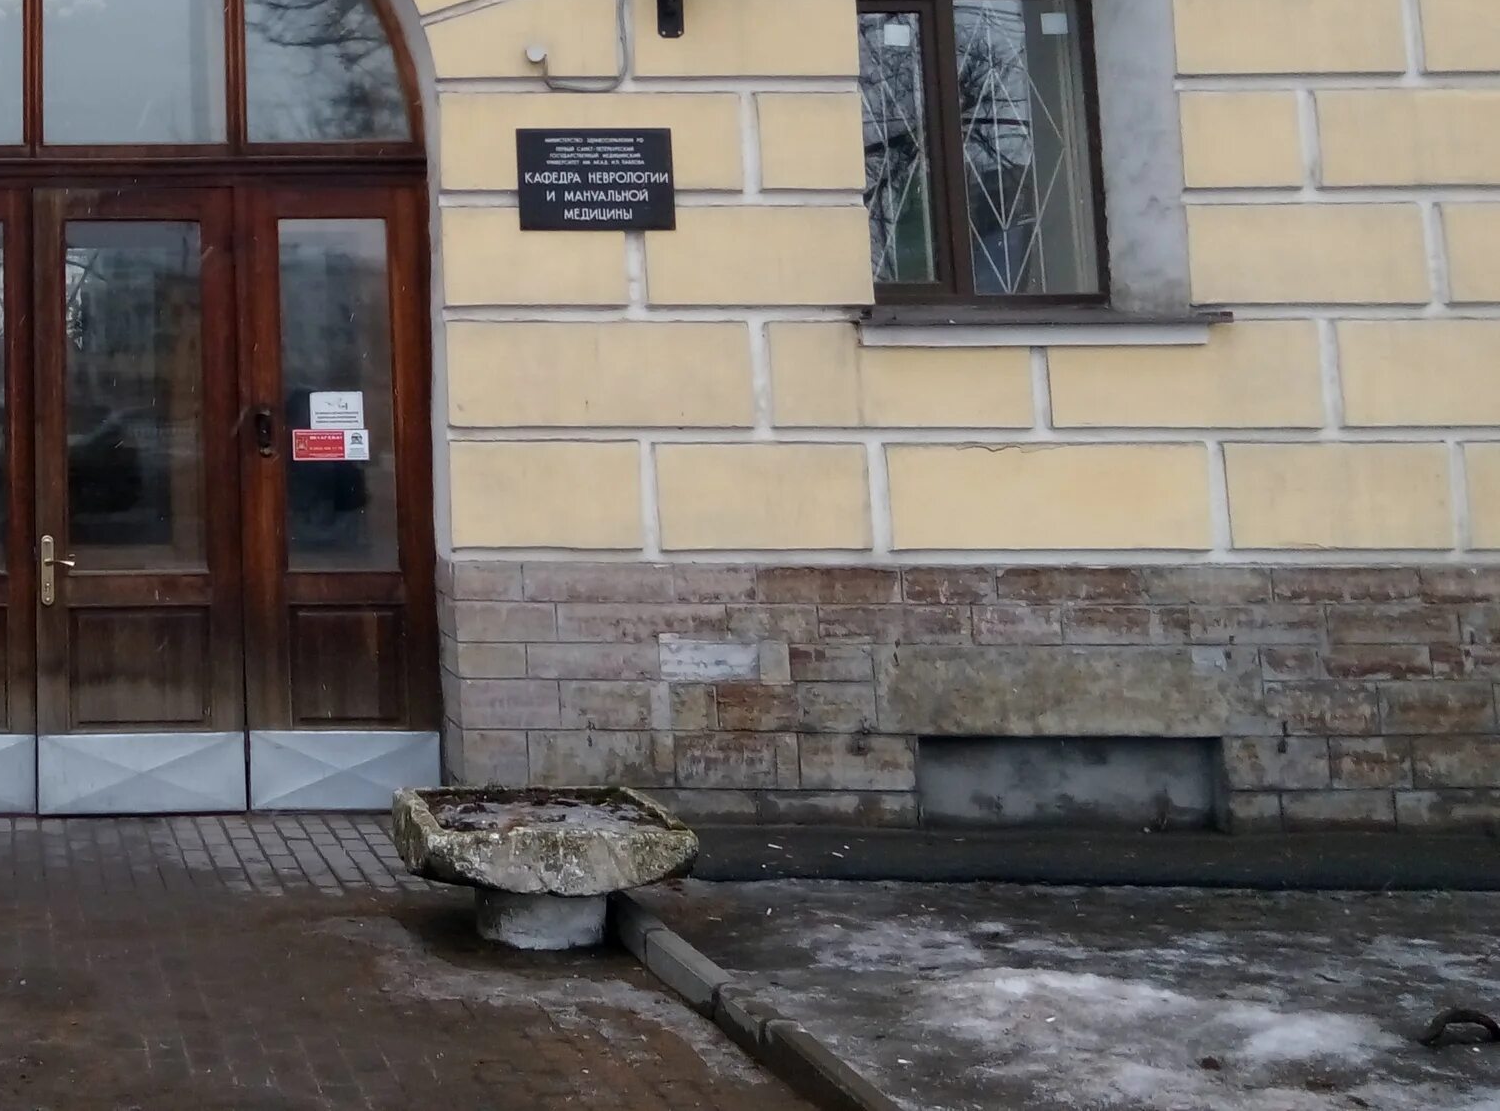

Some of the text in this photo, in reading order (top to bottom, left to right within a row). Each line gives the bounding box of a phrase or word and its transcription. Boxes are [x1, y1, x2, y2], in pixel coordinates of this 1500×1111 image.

[525, 171, 669, 184] КАФЕДРА НЕВРОЛОГИИ
[546, 189, 648, 202] И МАНУАЛЬНОЙ
[564, 208, 632, 220] МЕДИЦИНЫ
